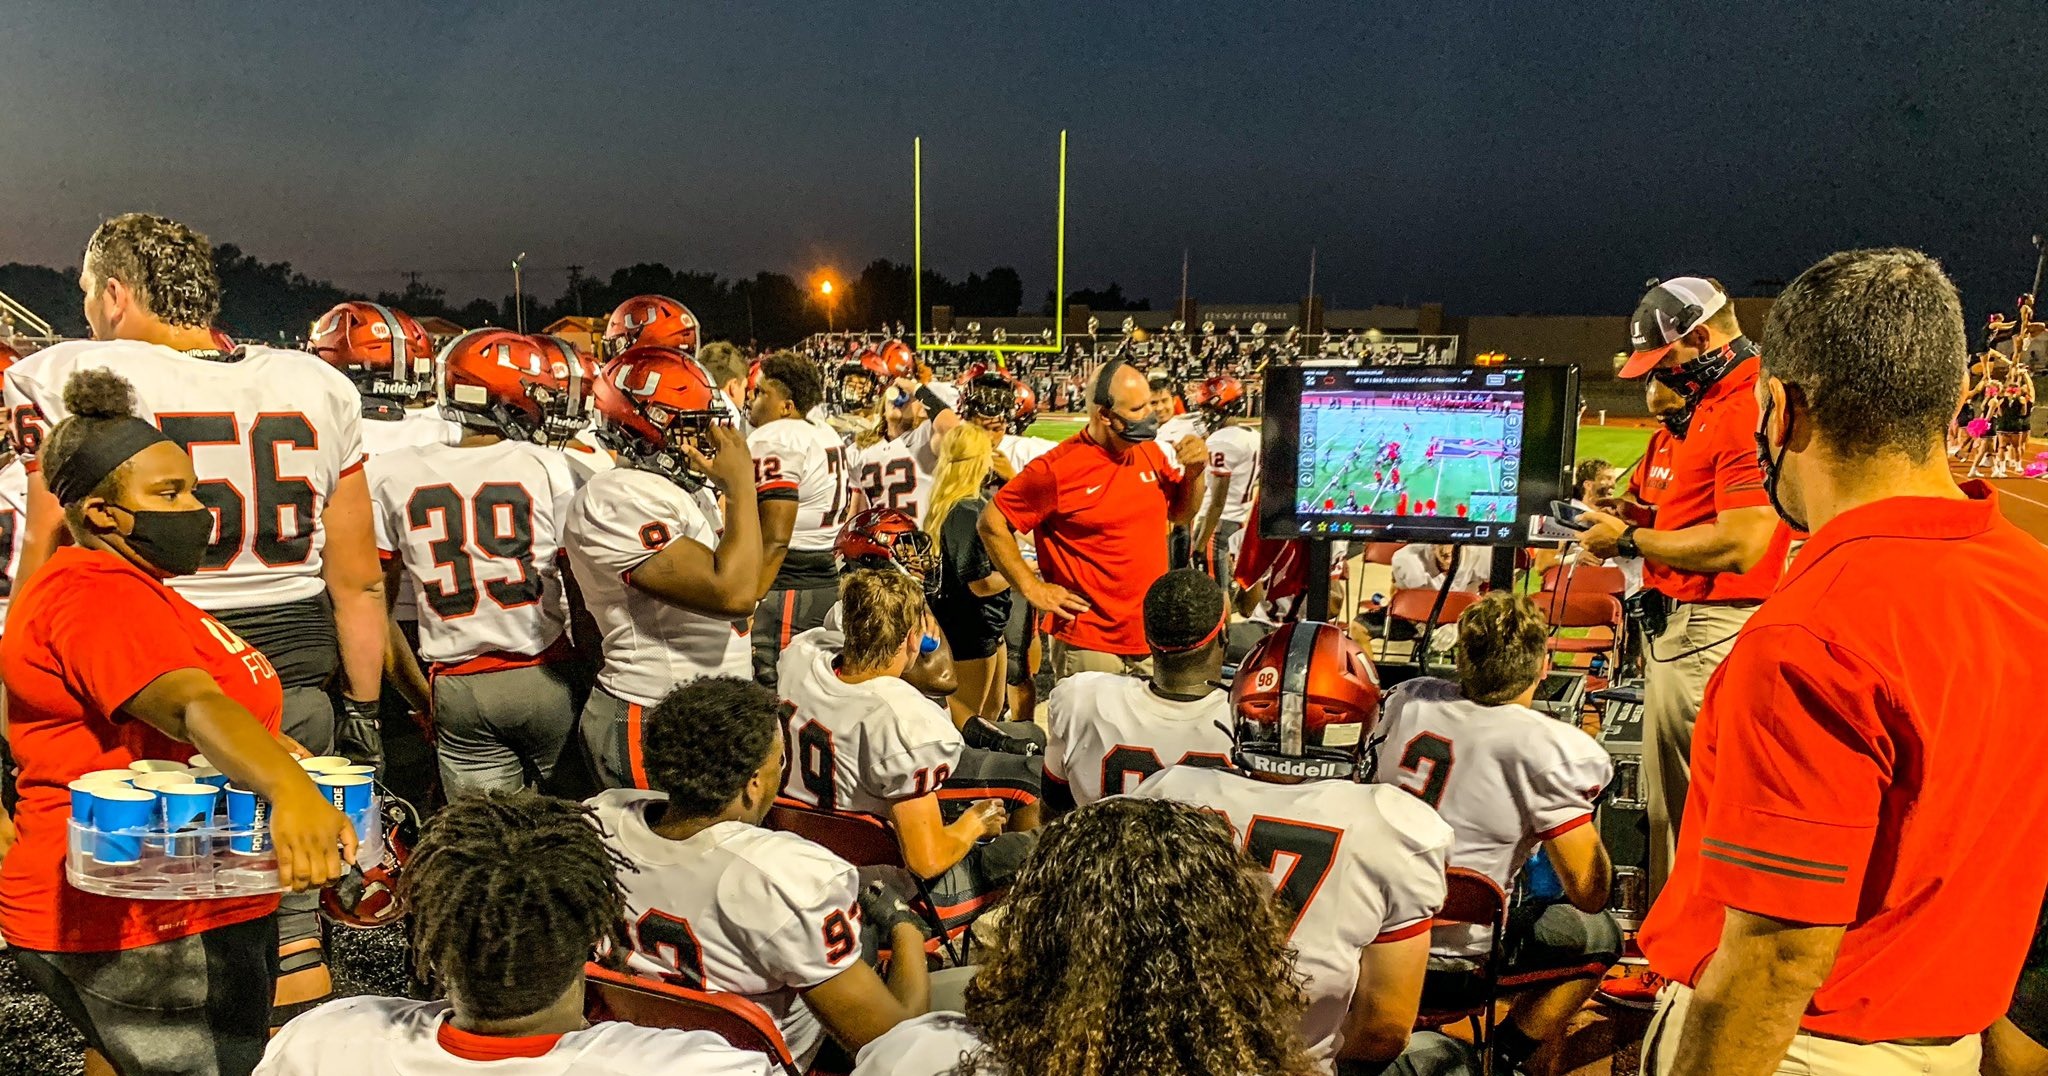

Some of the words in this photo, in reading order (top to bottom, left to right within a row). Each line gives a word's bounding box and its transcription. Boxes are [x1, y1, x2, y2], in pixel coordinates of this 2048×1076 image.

[1241, 312, 1287, 320] FOOTBALL
[497, 344, 541, 376] U
[373, 381, 421, 398] Riddell
[614, 364, 661, 396] U
[861, 456, 919, 520] 22
[1140, 470, 1157, 483] U
[154, 411, 318, 571] 56
[405, 481, 544, 622] 39
[1257, 672, 1275, 688] 98
[1254, 756, 1336, 777] Riddell
